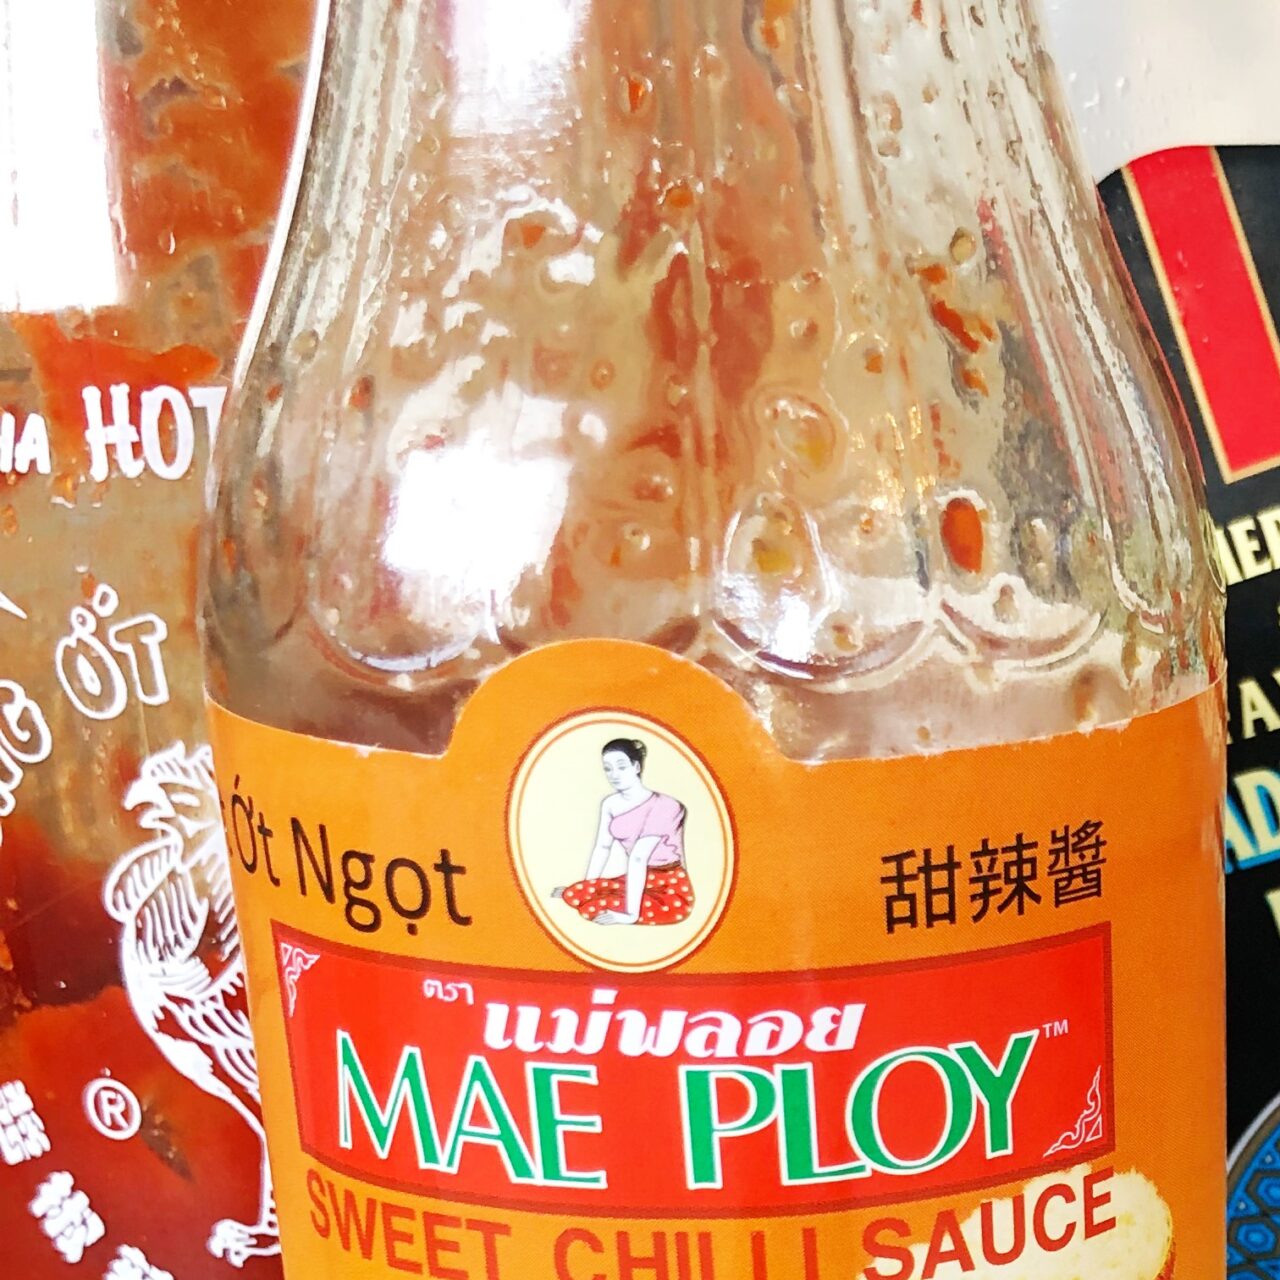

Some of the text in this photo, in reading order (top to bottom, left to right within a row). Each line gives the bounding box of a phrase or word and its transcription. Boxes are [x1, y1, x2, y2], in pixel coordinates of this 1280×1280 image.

[292, 817, 472, 935] Ngọt
[880, 820, 1107, 934] 甜辣醬
[423, 978, 865, 1057] ตรา แม่พลอย
[337, 1029, 607, 1189] MAE
[679, 1029, 1039, 1190] PLOY
